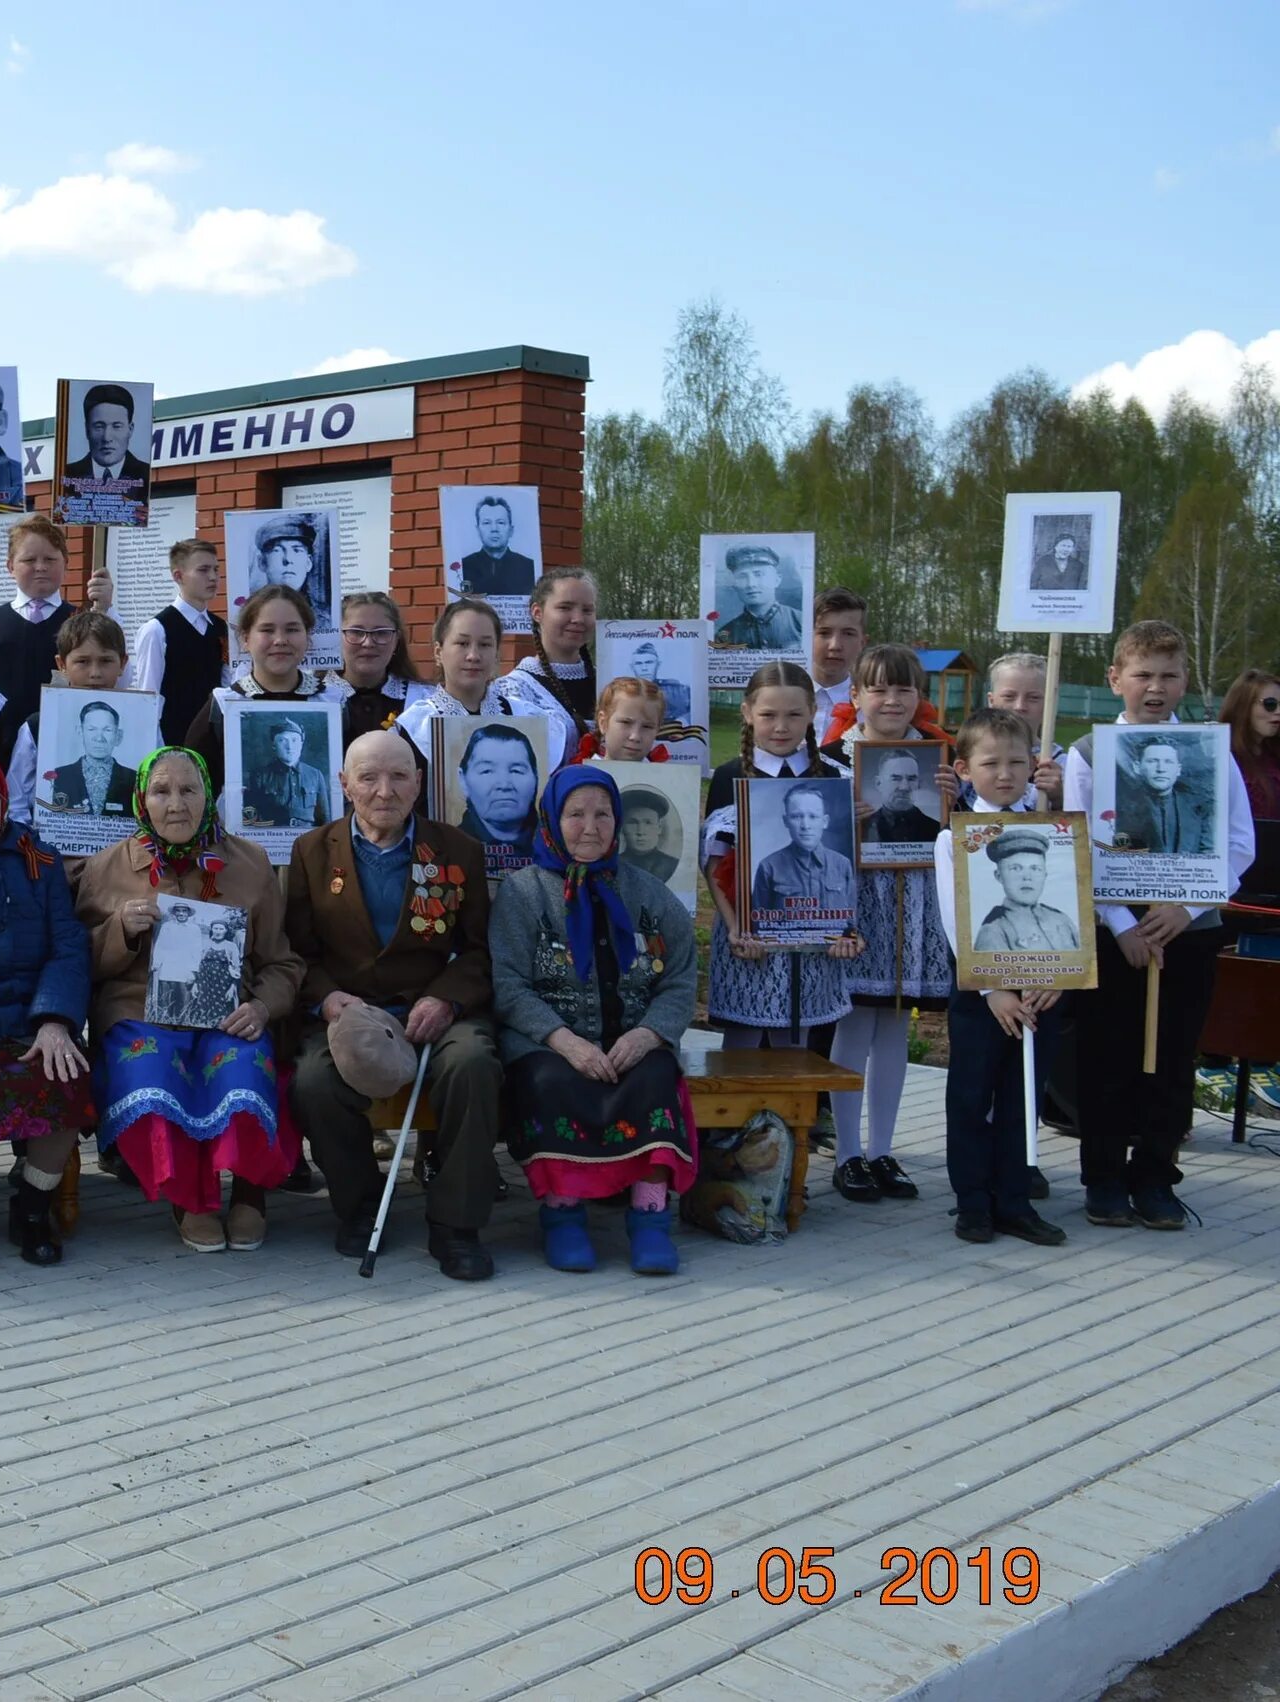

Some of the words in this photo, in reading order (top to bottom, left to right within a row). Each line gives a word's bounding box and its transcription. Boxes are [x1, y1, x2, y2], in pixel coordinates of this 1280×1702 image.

[311, 656, 340, 665] ПОЛК
[1093, 887, 1187, 898] БЕССМЕРТНЫЙ
[1191, 890, 1226, 899] ПОЛК
[994, 954, 1061, 963] Ворожцов
[972, 966, 1011, 974] Федор
[1002, 977, 1054, 985] рядовой
